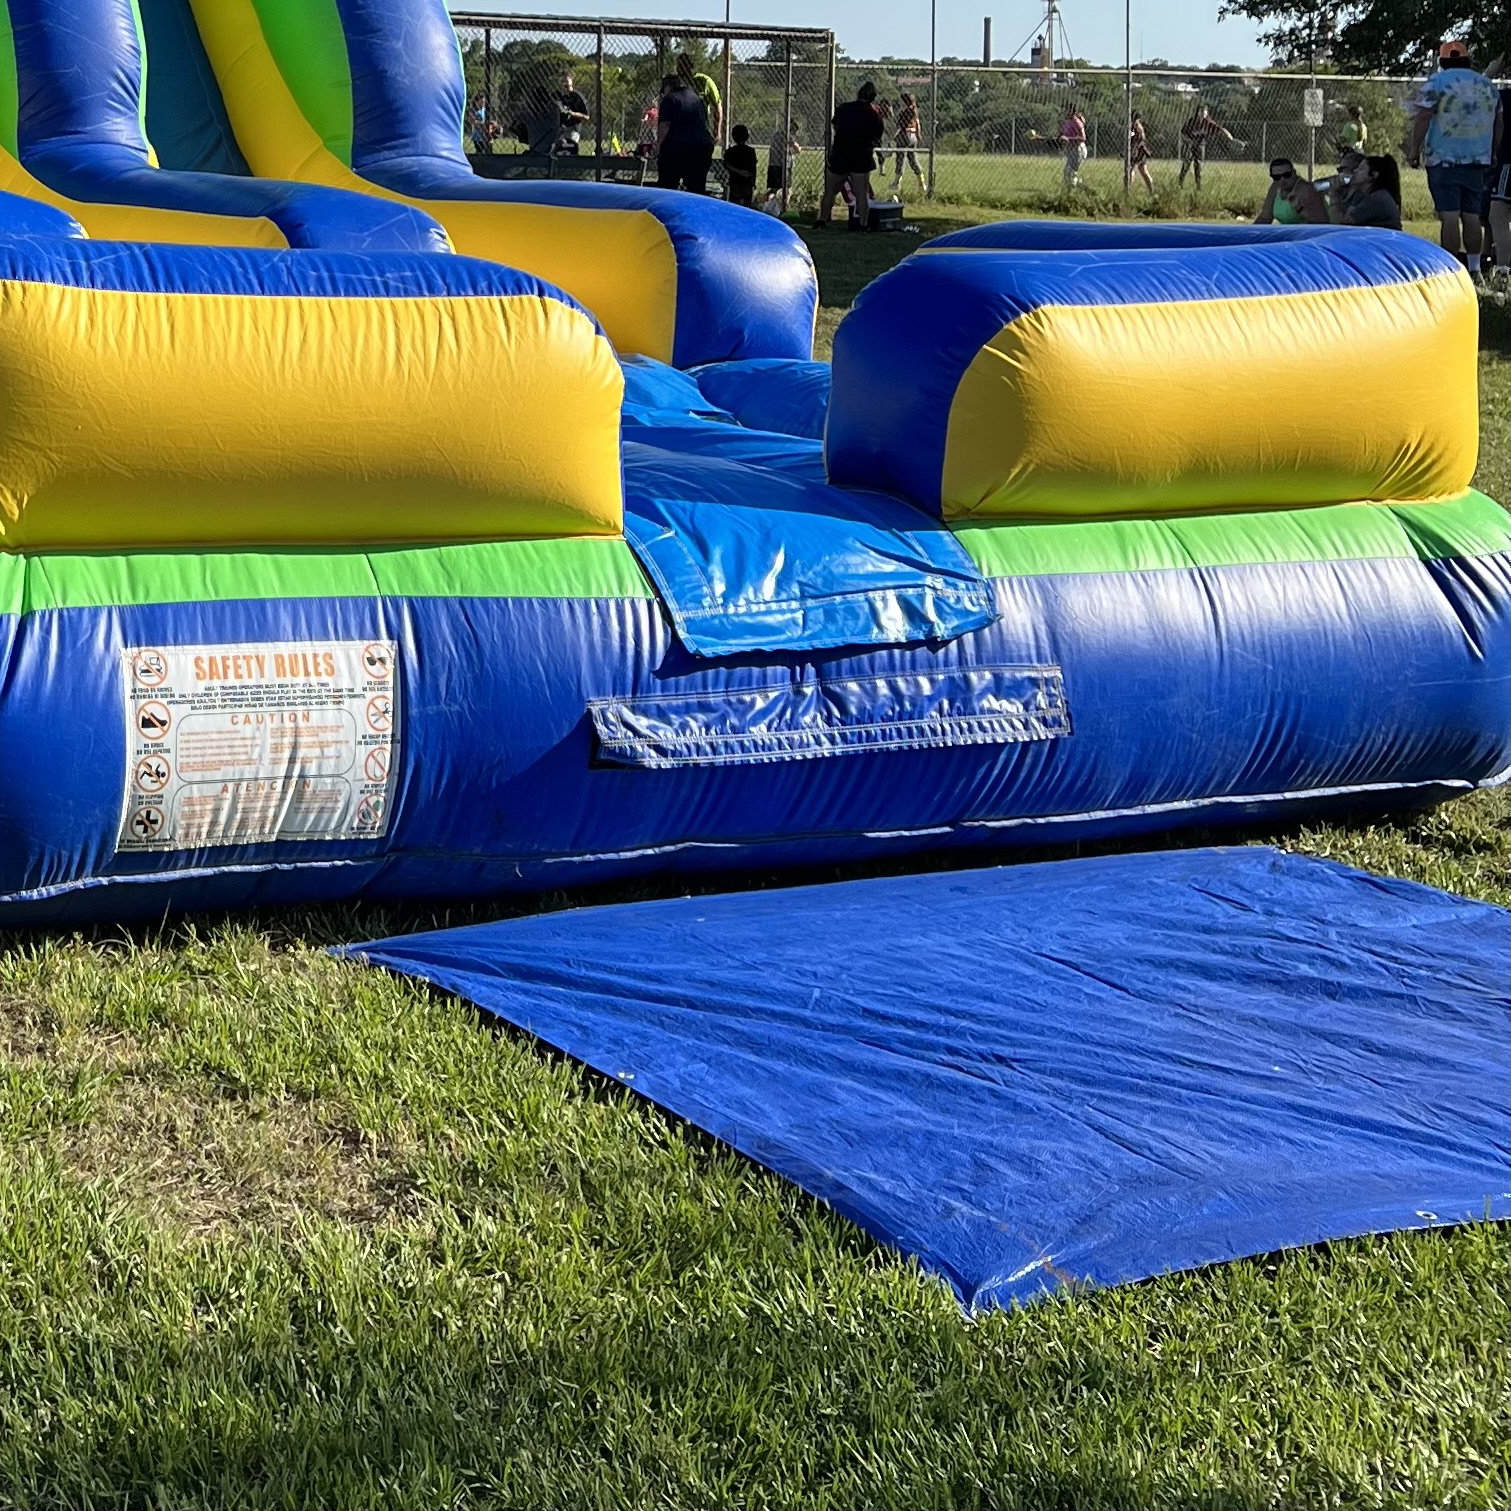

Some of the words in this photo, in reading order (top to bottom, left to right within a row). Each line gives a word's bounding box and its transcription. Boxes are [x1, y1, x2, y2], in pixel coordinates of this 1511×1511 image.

[194, 654, 266, 681] SAFETY
[275, 652, 336, 678] RULES
[231, 711, 311, 726] CAUTION
